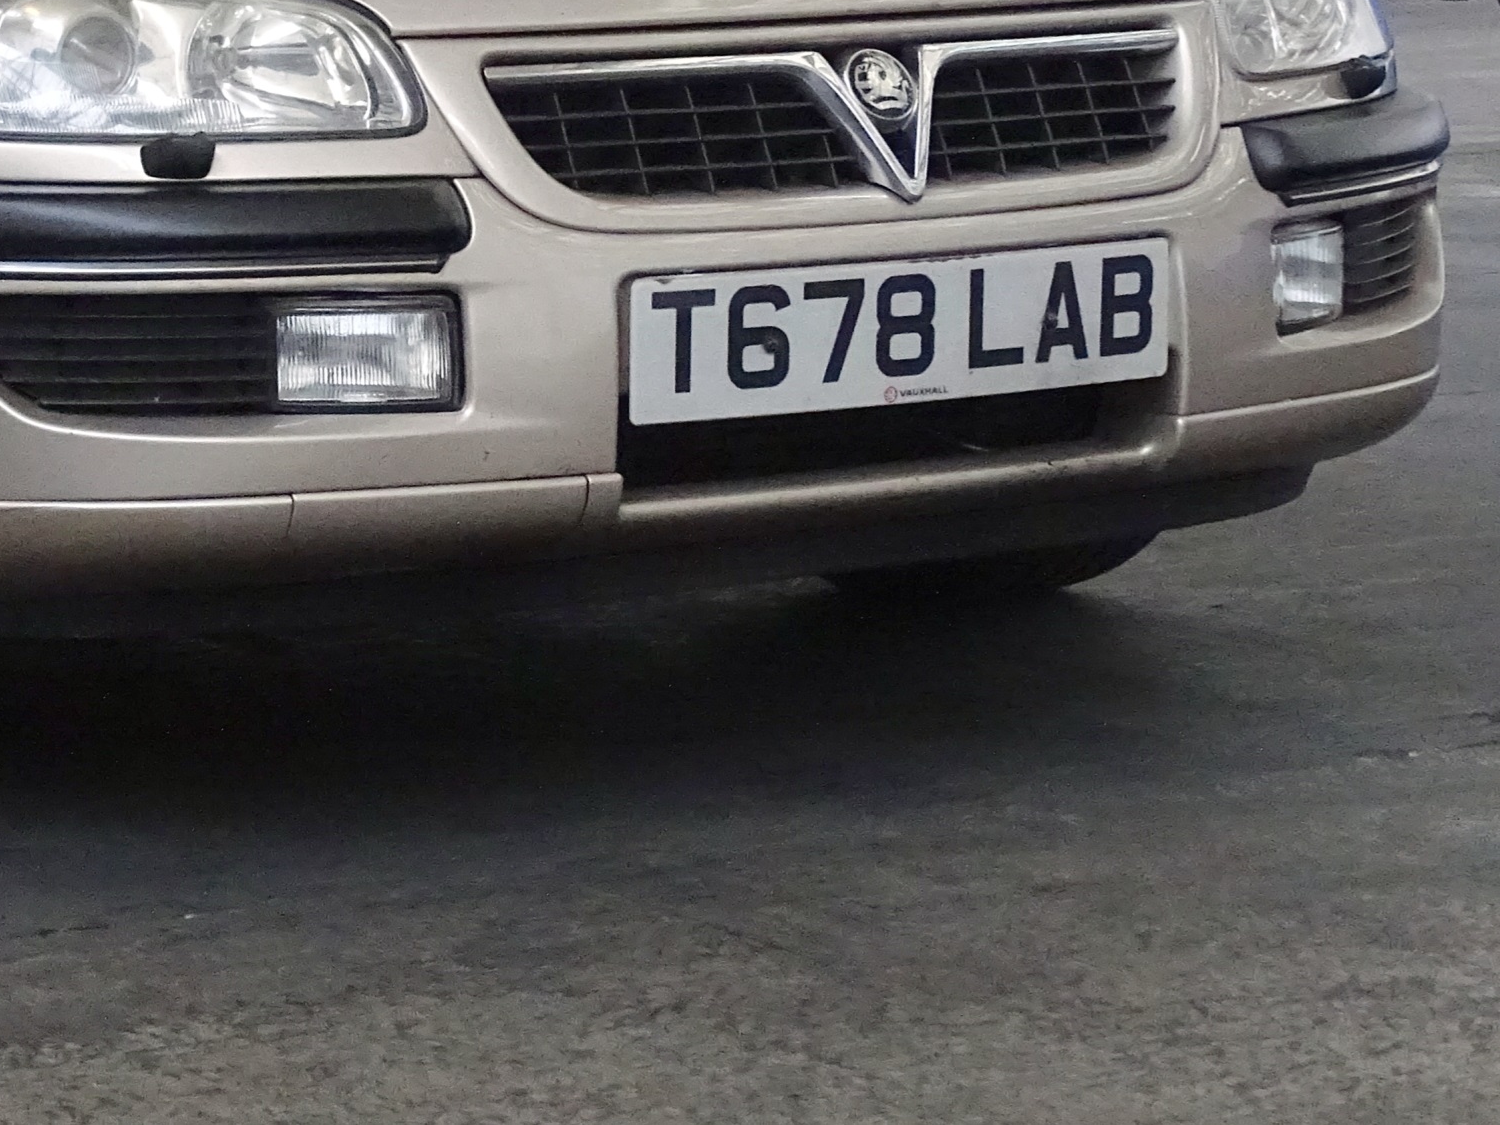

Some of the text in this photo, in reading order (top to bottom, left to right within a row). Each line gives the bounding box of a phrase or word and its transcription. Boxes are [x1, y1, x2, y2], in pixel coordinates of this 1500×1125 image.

[651, 254, 1154, 394] T678 LAB
[900, 385, 948, 397] VAUXHALL
